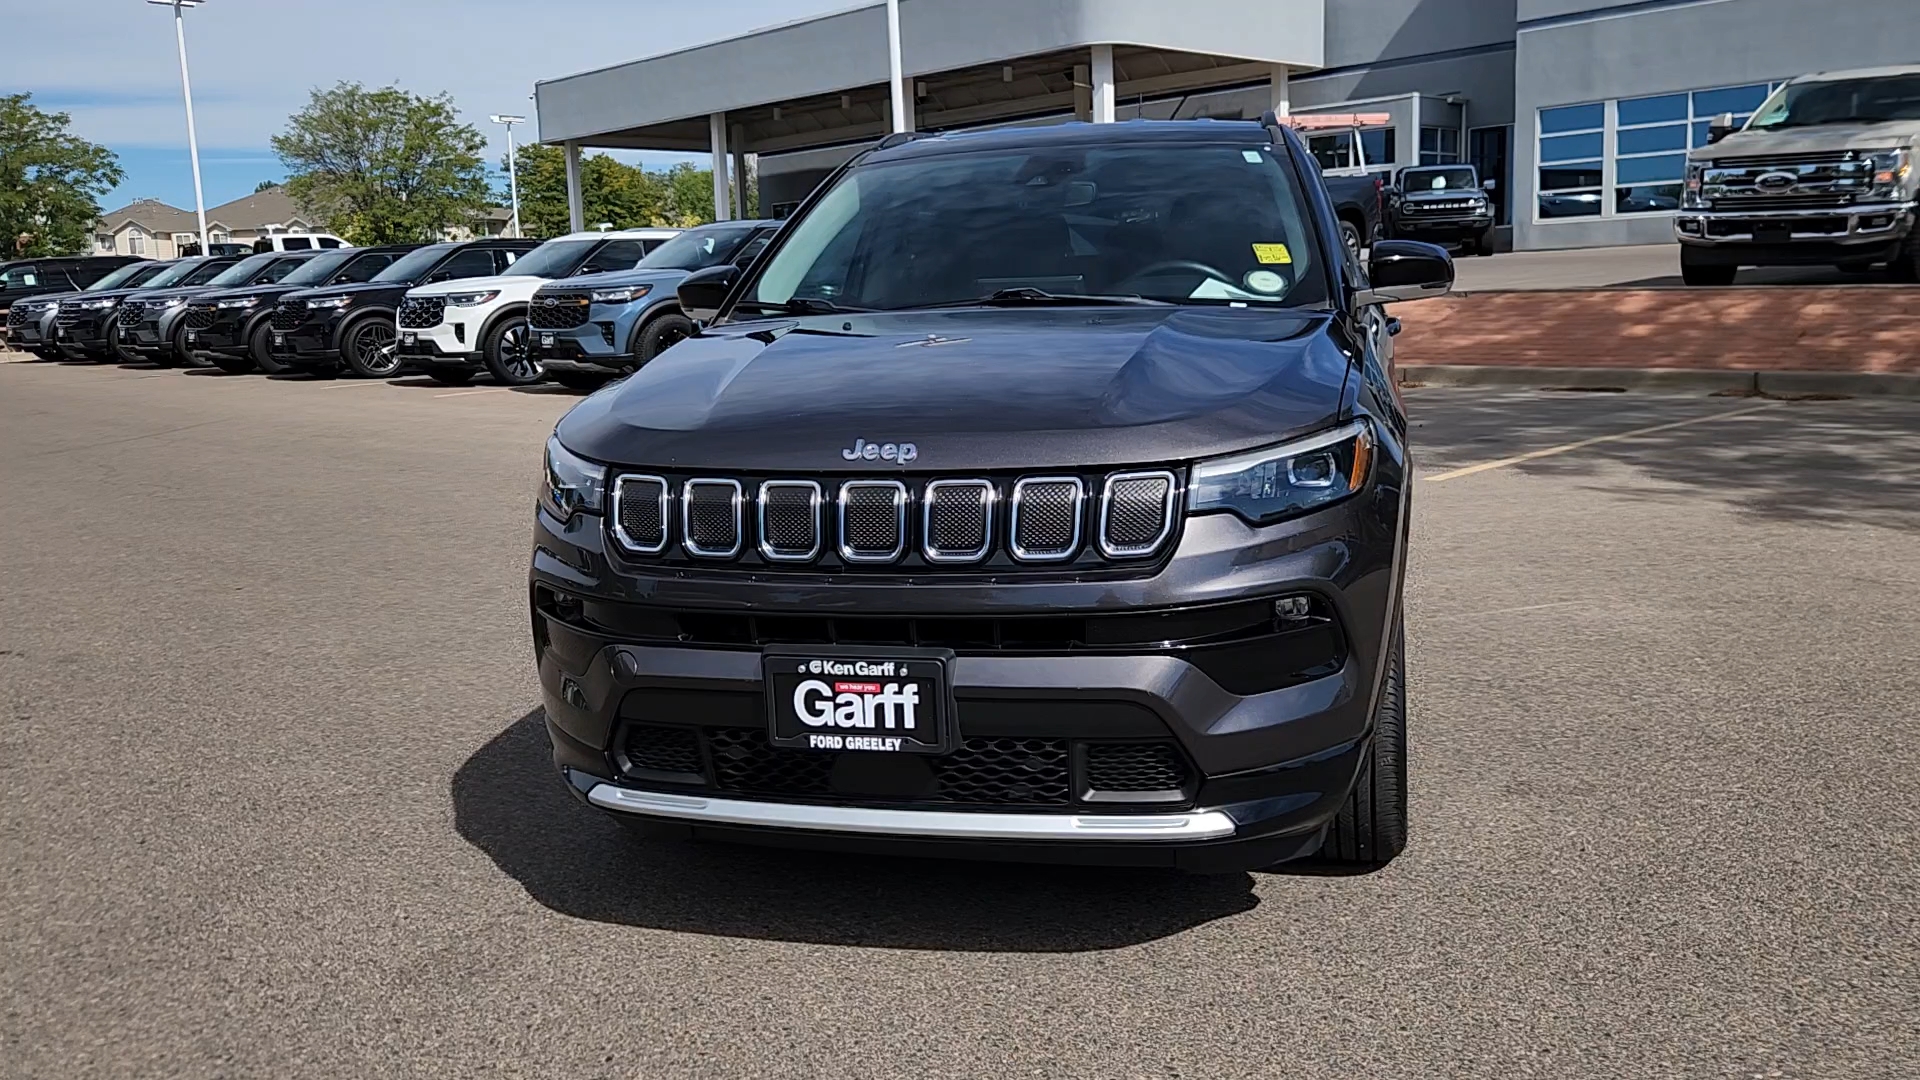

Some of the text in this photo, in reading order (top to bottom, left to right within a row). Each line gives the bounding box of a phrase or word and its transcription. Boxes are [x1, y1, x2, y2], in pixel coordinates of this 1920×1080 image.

[842, 438, 917, 464] Jeep
[823, 660, 855, 676] Ken
[855, 661, 895, 676] Garff
[794, 679, 919, 729] Garff
[809, 735, 902, 751] FORD GREELEY
